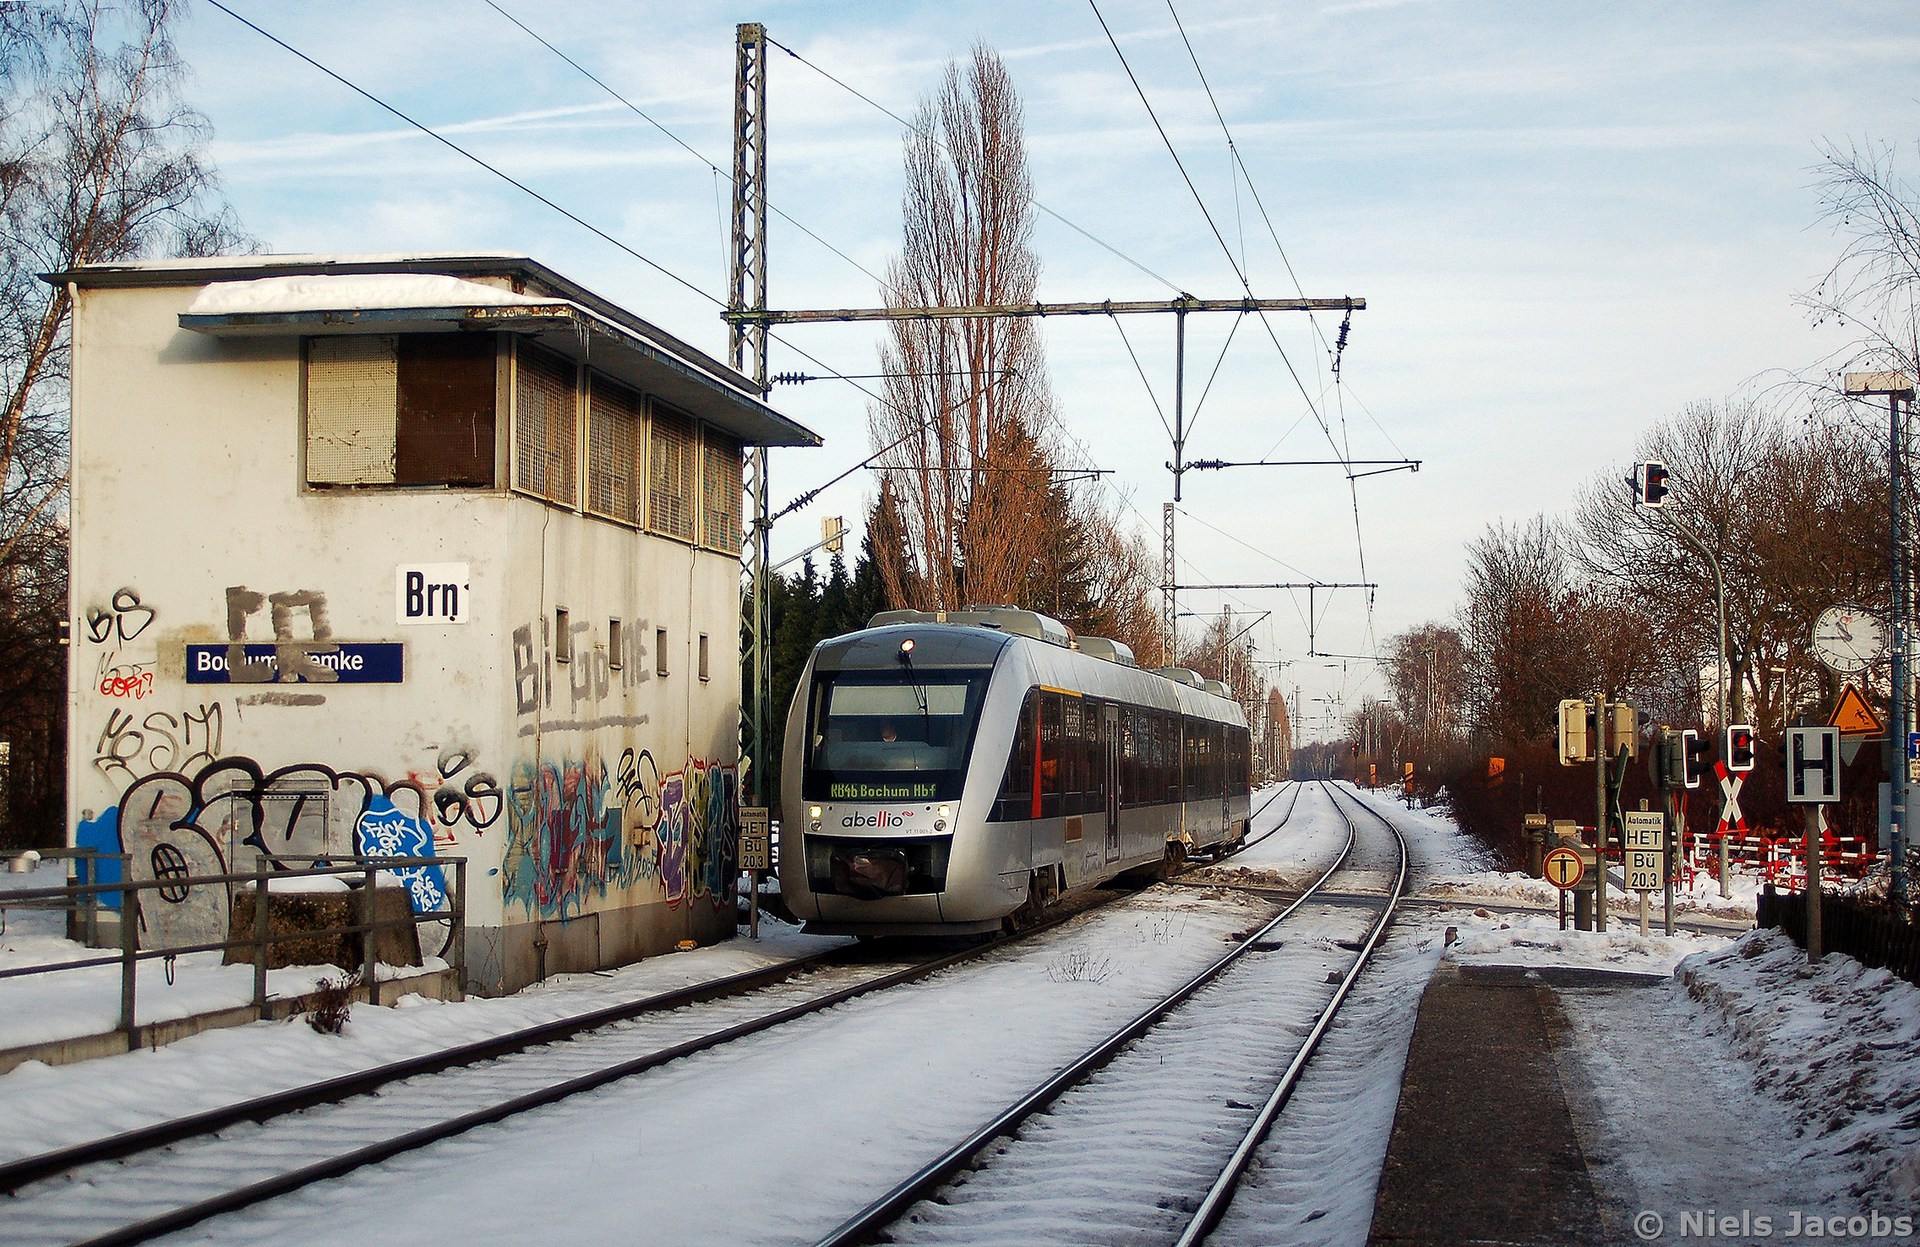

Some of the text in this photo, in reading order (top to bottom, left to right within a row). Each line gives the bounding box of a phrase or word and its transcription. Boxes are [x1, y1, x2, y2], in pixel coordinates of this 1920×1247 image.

[1793, 733, 1834, 795] H
[860, 784, 909, 797] Bochum
[913, 783, 936, 797] Hbf
[842, 811, 903, 827] abellio
[740, 822, 767, 833] HET
[1627, 830, 1661, 845] HET
[745, 840, 761, 852] Bü
[1634, 853, 1655, 868] Bü
